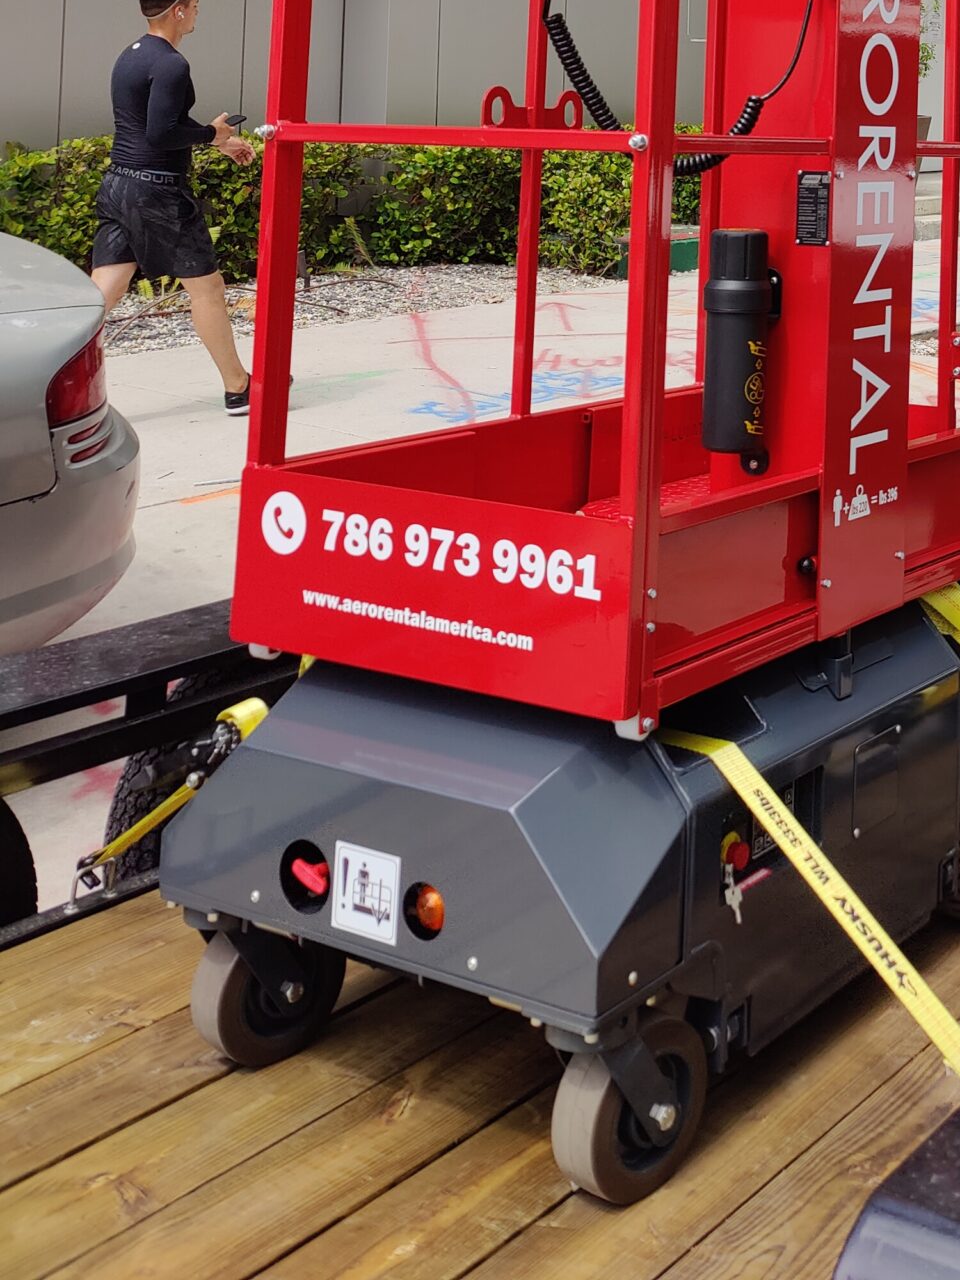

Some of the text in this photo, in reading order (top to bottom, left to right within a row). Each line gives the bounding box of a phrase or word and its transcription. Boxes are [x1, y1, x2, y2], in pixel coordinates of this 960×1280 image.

[115, 166, 174, 184] ARMOUR
[321, 508, 601, 601] 786 973 9961
[302, 589, 534, 652] www.aerorentalamerica.com
[753, 788, 898, 970] HUSKY WLL 3333lbs
